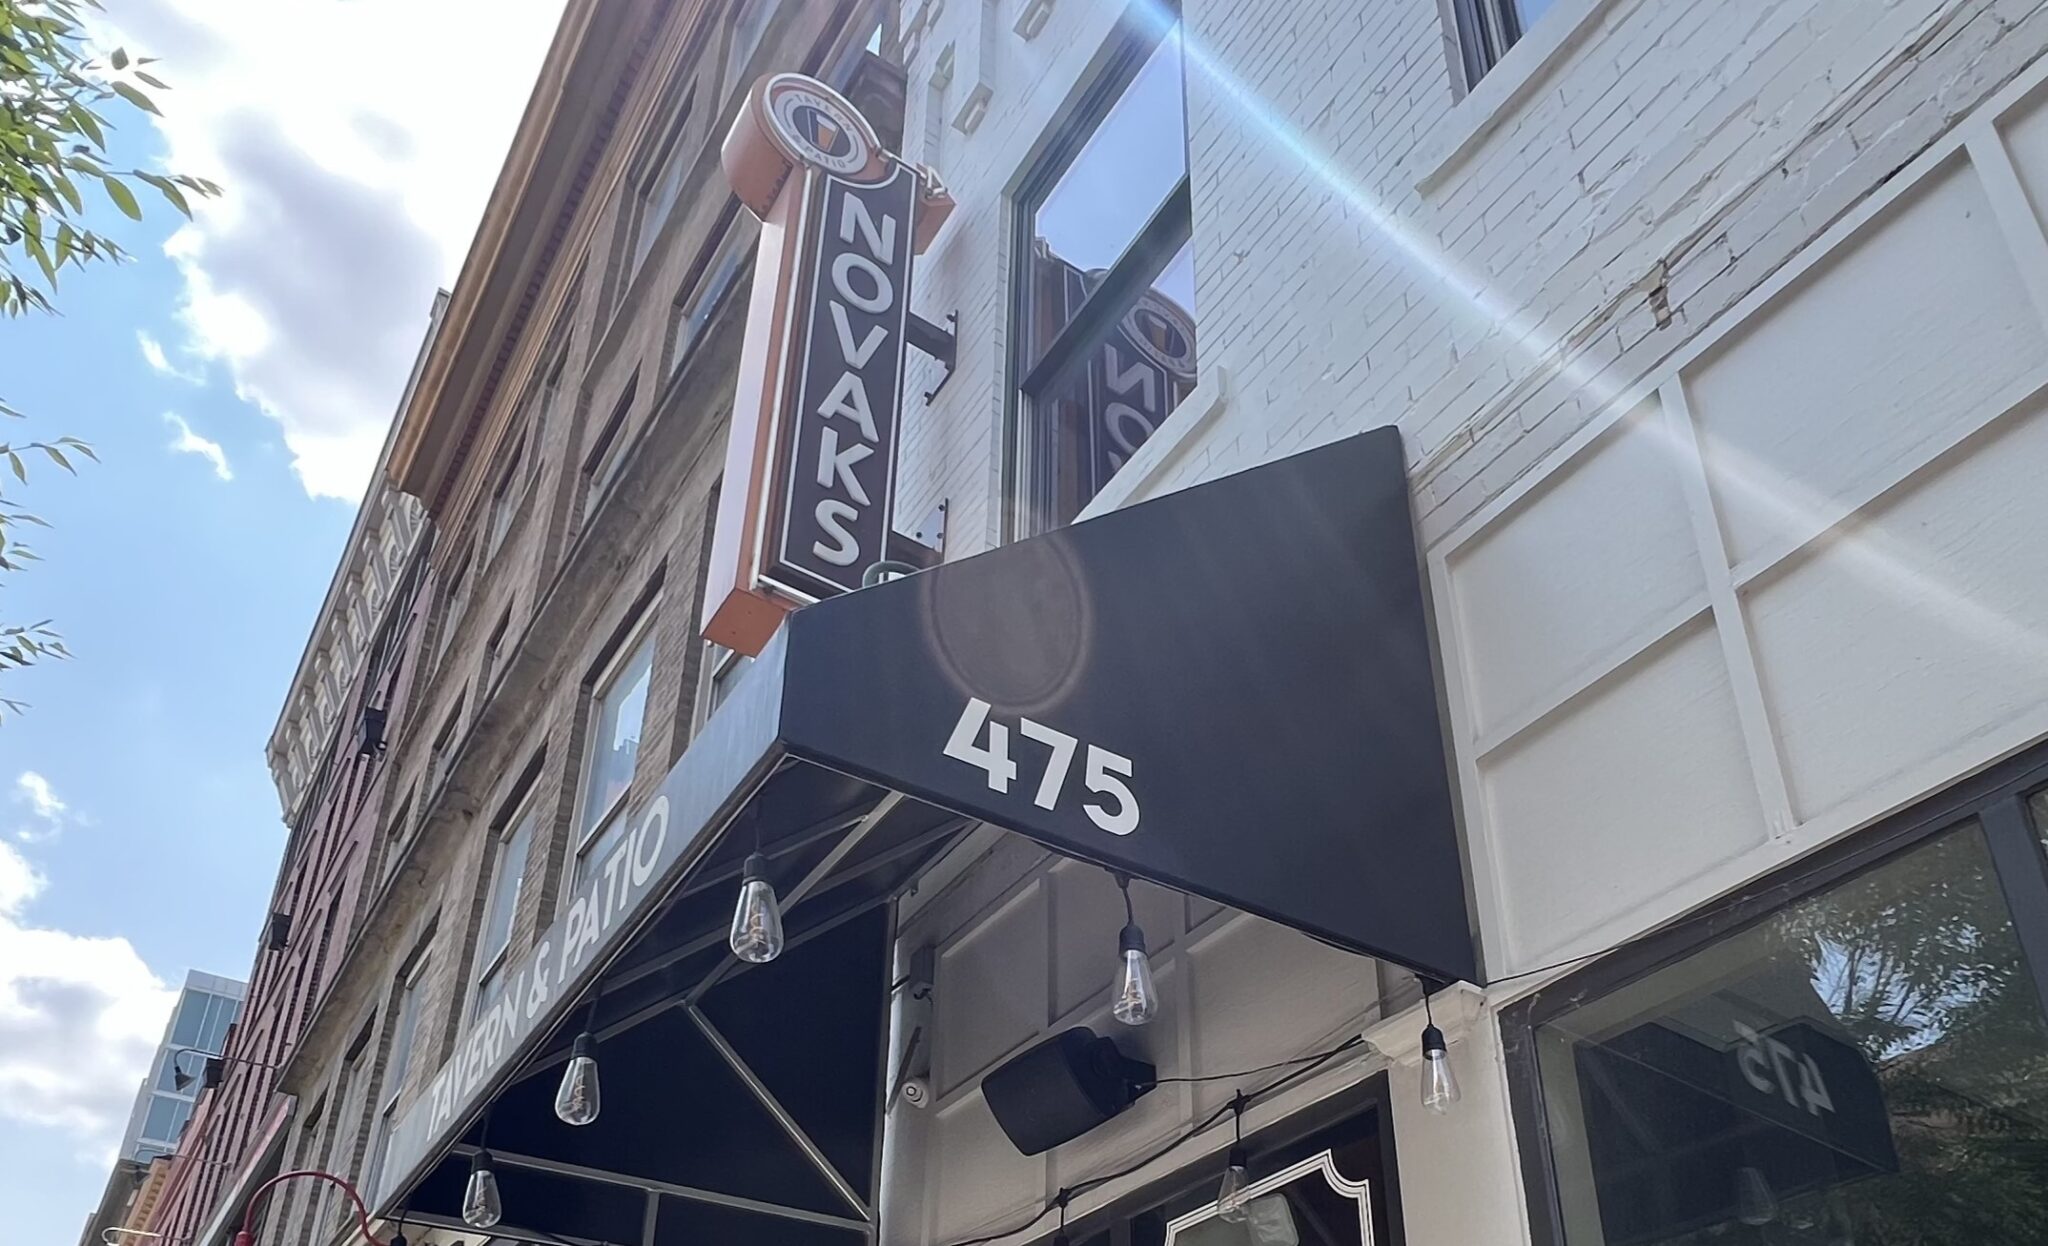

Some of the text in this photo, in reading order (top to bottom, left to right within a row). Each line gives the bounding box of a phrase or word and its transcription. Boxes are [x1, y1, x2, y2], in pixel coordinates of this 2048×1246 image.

[795, 94, 854, 132] TAVERN
[805, 146, 846, 168] PATIO
[813, 191, 896, 567] NOVAKS
[943, 697, 1140, 836] 475
[427, 794, 670, 1142] TAVERN & PATIO
